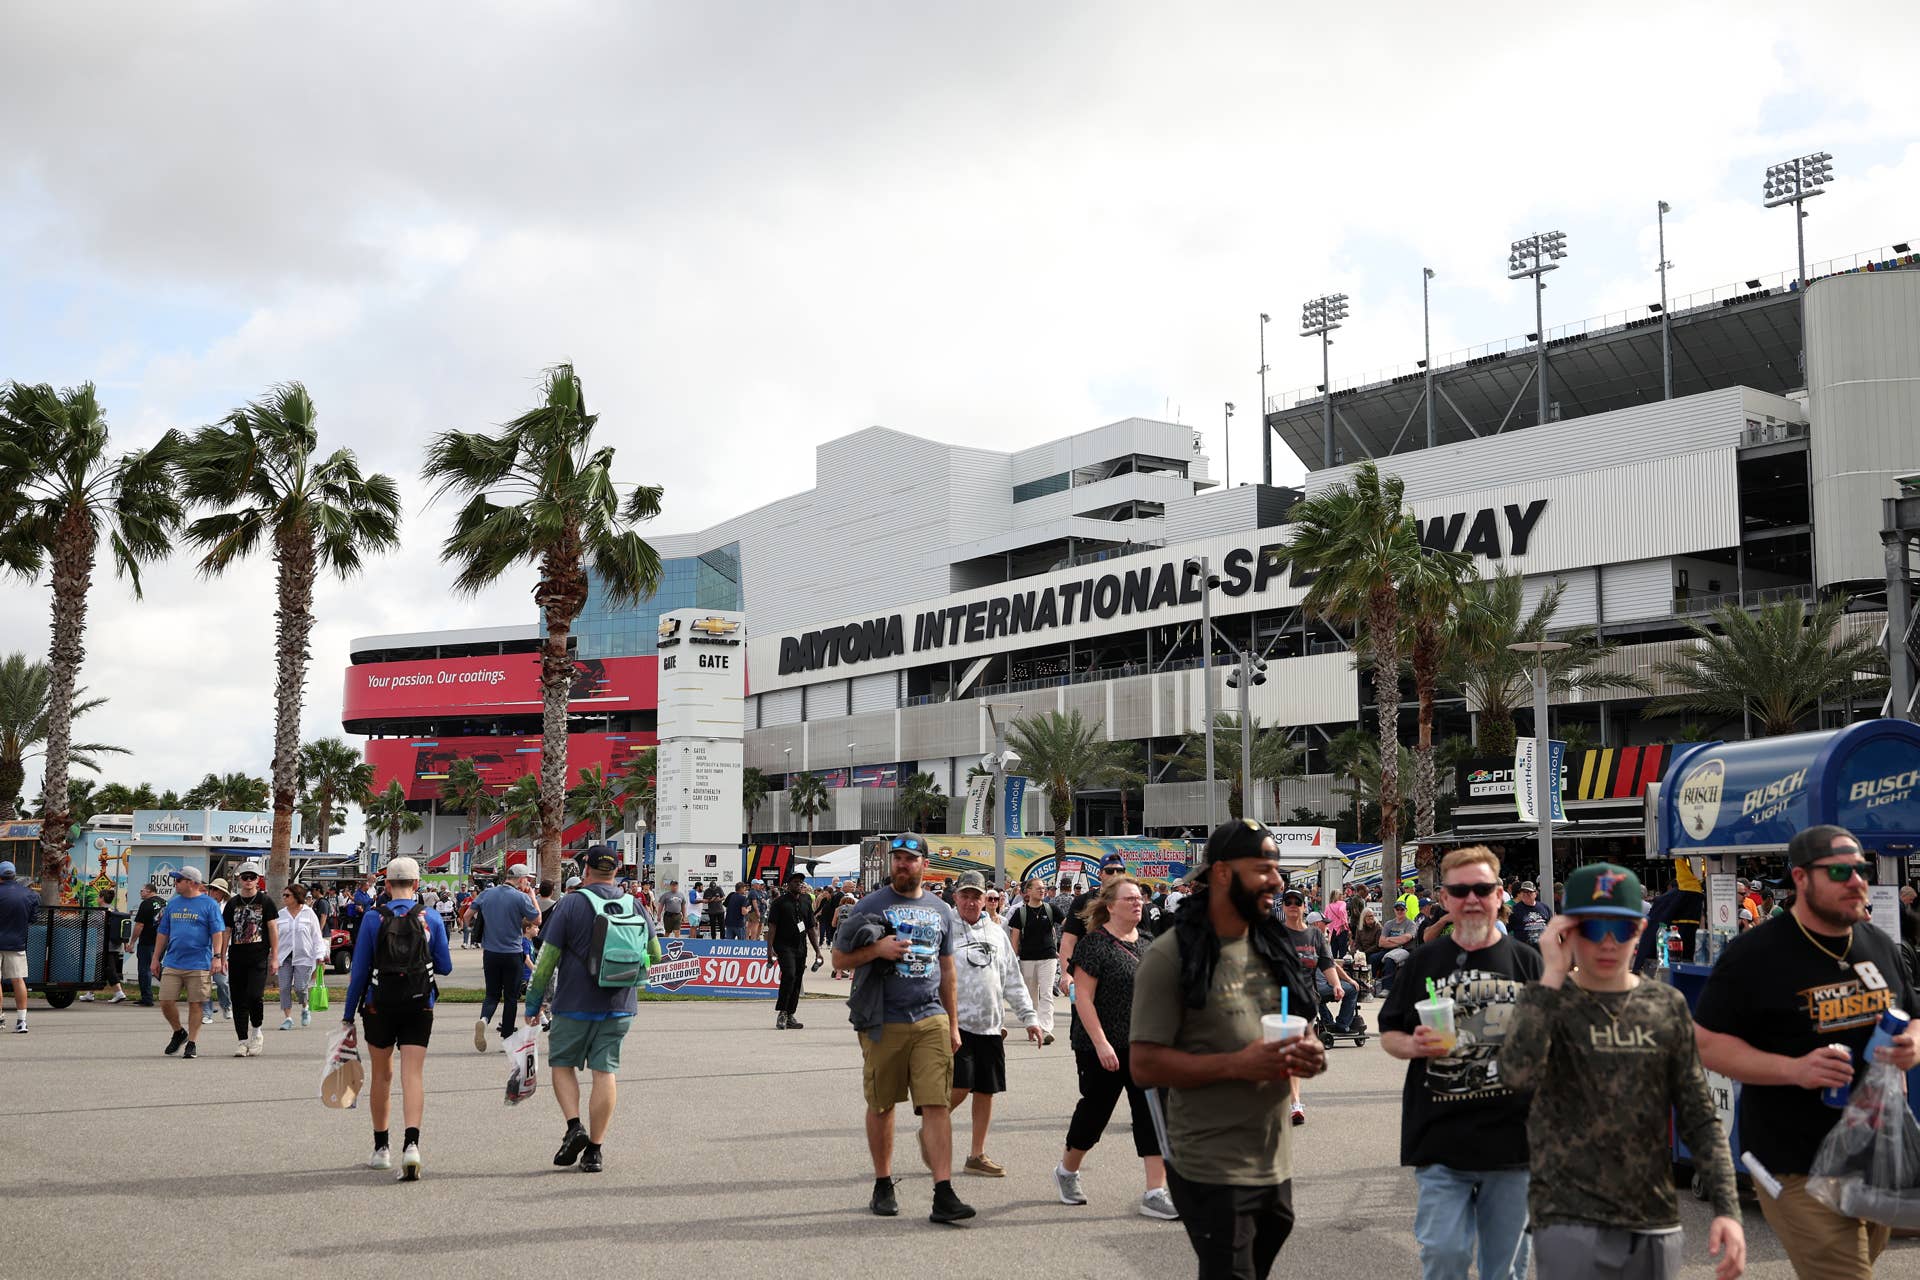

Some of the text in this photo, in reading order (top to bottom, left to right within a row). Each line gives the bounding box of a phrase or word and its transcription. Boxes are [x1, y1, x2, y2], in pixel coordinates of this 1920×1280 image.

[778, 614, 904, 676] DAYTONA
[912, 558, 1203, 652] INTERNATIONAL
[663, 655, 677, 671] GATE
[698, 654, 729, 669] GATE
[368, 668, 506, 690] Your passion. Our coatings.
[1525, 742, 1535, 816] AdventHealth
[1551, 746, 1560, 816] feel whole
[1683, 785, 1718, 806] BUSCH
[1742, 767, 1808, 817] BUSCH
[1866, 789, 1912, 808] LIGHT
[972, 778, 988, 830] AdventHealth
[1011, 780, 1020, 833] feel whole
[1754, 796, 1791, 825] LIGHT
[1269, 833, 1313, 845] ograms
[709, 946, 768, 956] A DUI CAN COS
[650, 959, 699, 975] DRIVE SOBER OR
[661, 970, 684, 981] PULLED
[684, 967, 700, 979] OVER
[1853, 960, 1889, 990] 8
[1813, 985, 1849, 1001] KYLE
[1818, 989, 1891, 1022] BUSCH
